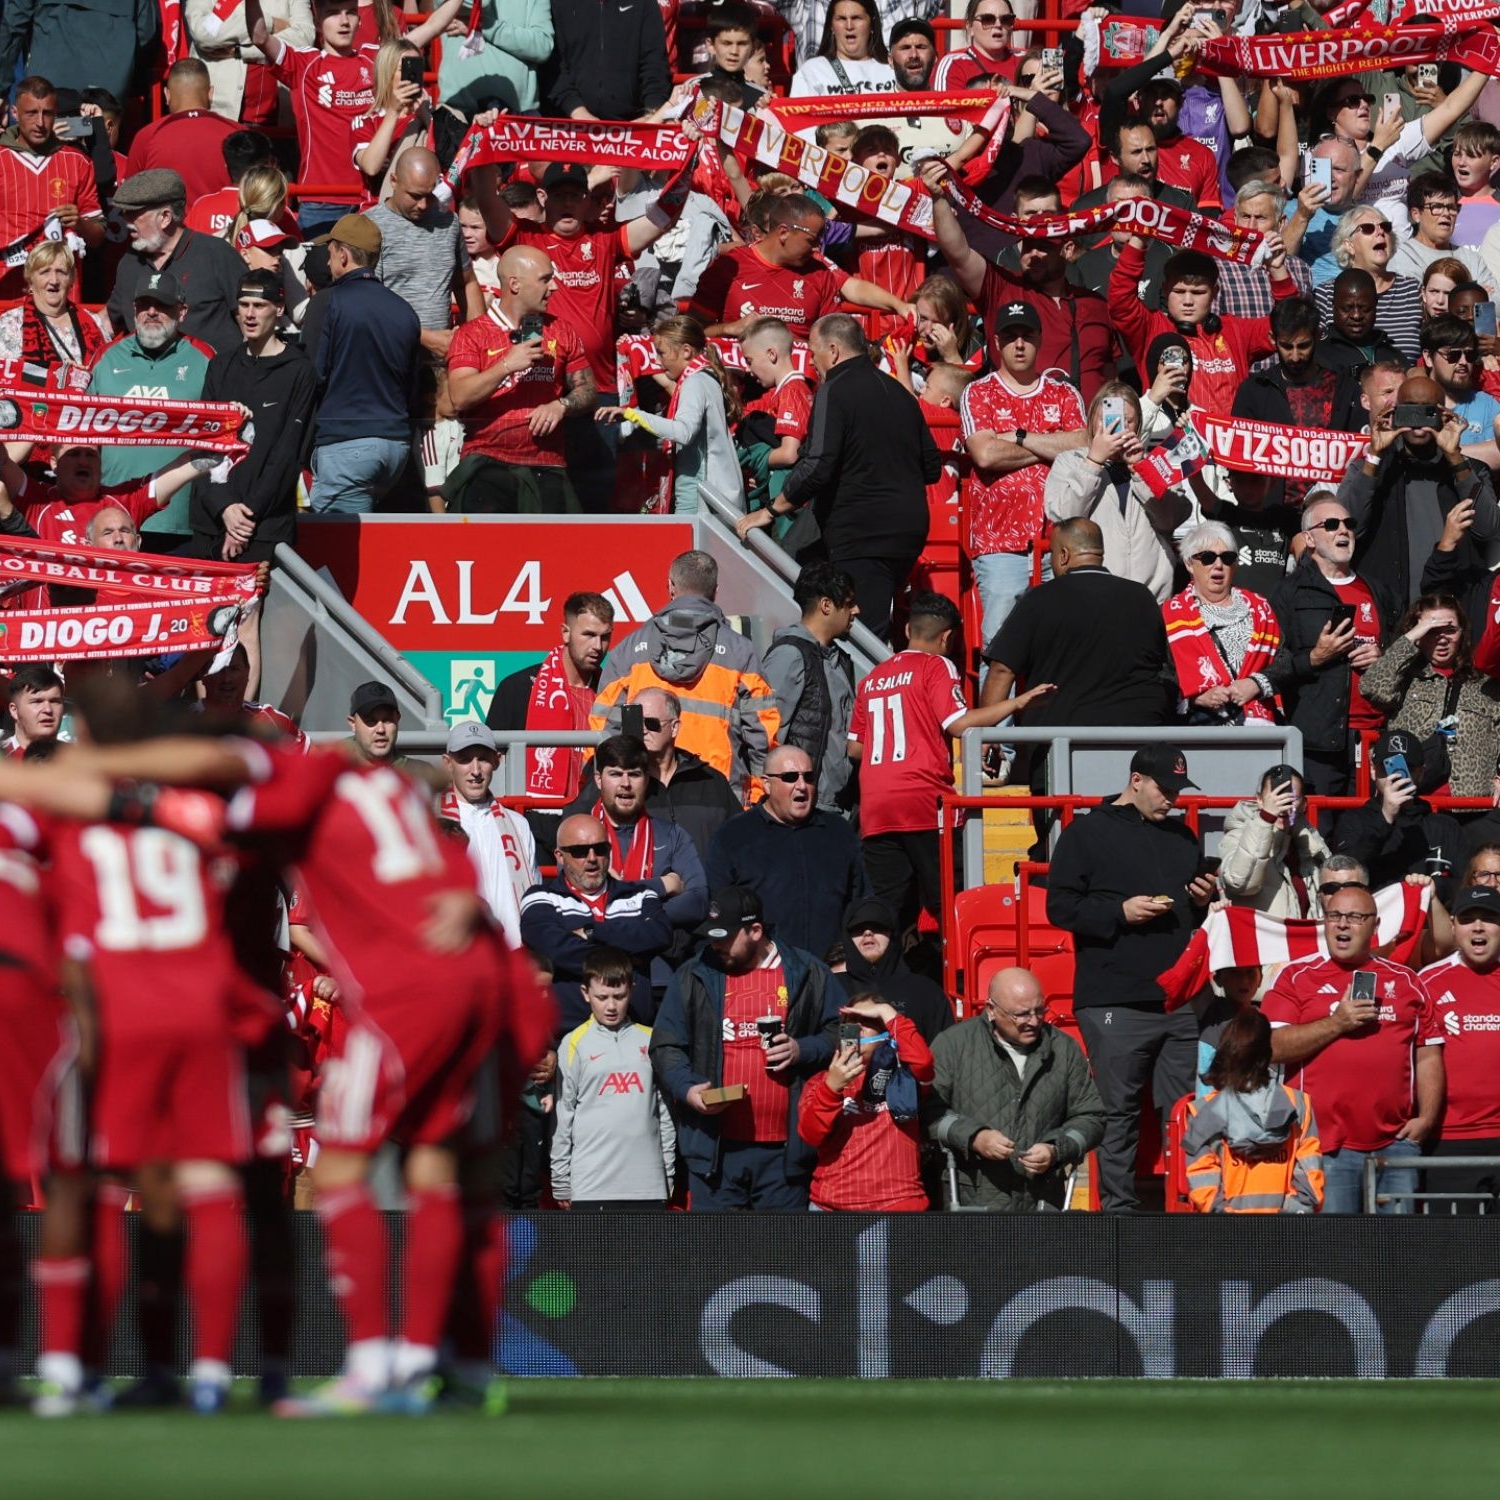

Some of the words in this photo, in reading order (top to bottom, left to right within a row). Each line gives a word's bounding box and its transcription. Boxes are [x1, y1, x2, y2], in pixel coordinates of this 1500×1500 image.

[1254, 35, 1433, 71] LIVERPOOL
[1292, 68, 1311, 77] THE
[1313, 63, 1355, 76] MIGHTY
[1359, 57, 1391, 69] REDS
[940, 97, 993, 108] ALONE
[488, 121, 643, 145] LIVERPOOL
[655, 130, 690, 150] FC
[490, 139, 536, 152] YOU'LL
[541, 138, 587, 153] NEVER
[592, 142, 636, 157] WALK
[721, 105, 904, 212] LIVERPOOL
[1112, 222, 1159, 238] ALLEZ
[759, 305, 804, 317] standard
[56, 404, 169, 433] DIOGO
[171, 413, 200, 435] J.
[203, 421, 221, 433] 20
[1232, 420, 1283, 434] HUNGARY
[1287, 429, 1293, 437] &
[1299, 430, 1355, 441] LIVERPOOL
[1253, 462, 1333, 480] DOMINIK
[131, 573, 212, 593] CLUB
[388, 560, 552, 625] AL4
[20, 614, 134, 649] DIOGO
[141, 613, 169, 642] J.
[170, 619, 188, 633] 20
[534, 662, 551, 708] ALONE
[864, 678, 876, 693] M.
[876, 672, 913, 692] SALAH
[868, 694, 907, 766] 11
[530, 776, 554, 790] L.F.C.
[80, 824, 207, 951] 19
[1463, 1014, 1500, 1023] standa
[599, 1072, 644, 1096] AXA
